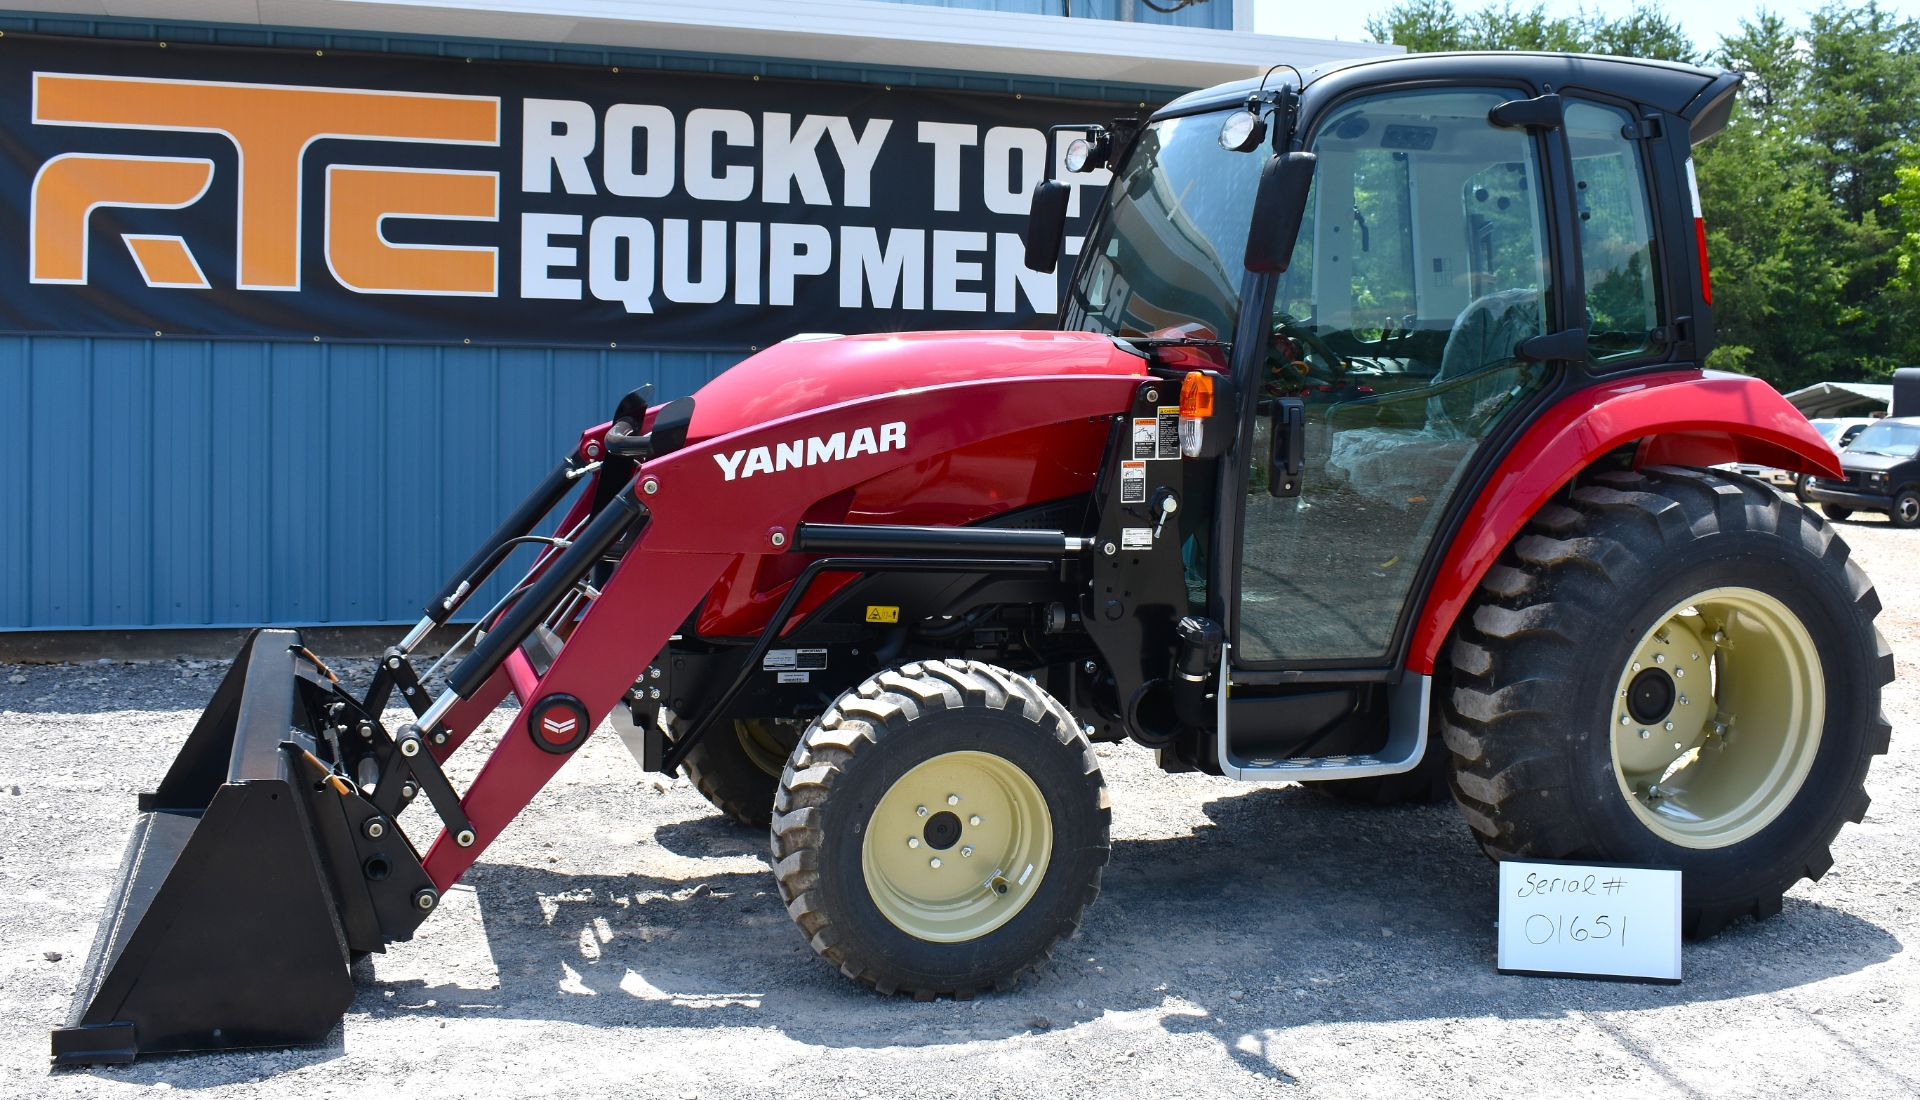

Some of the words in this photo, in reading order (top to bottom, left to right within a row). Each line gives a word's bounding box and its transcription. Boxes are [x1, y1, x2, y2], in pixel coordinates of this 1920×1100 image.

[521, 97, 893, 208] ROCKY
[29, 71, 501, 297] RTE
[712, 421, 907, 481] YANMAR
[1517, 872, 1597, 898] Serial
[1602, 876, 1629, 896] #
[1525, 913, 1627, 947] 01651
